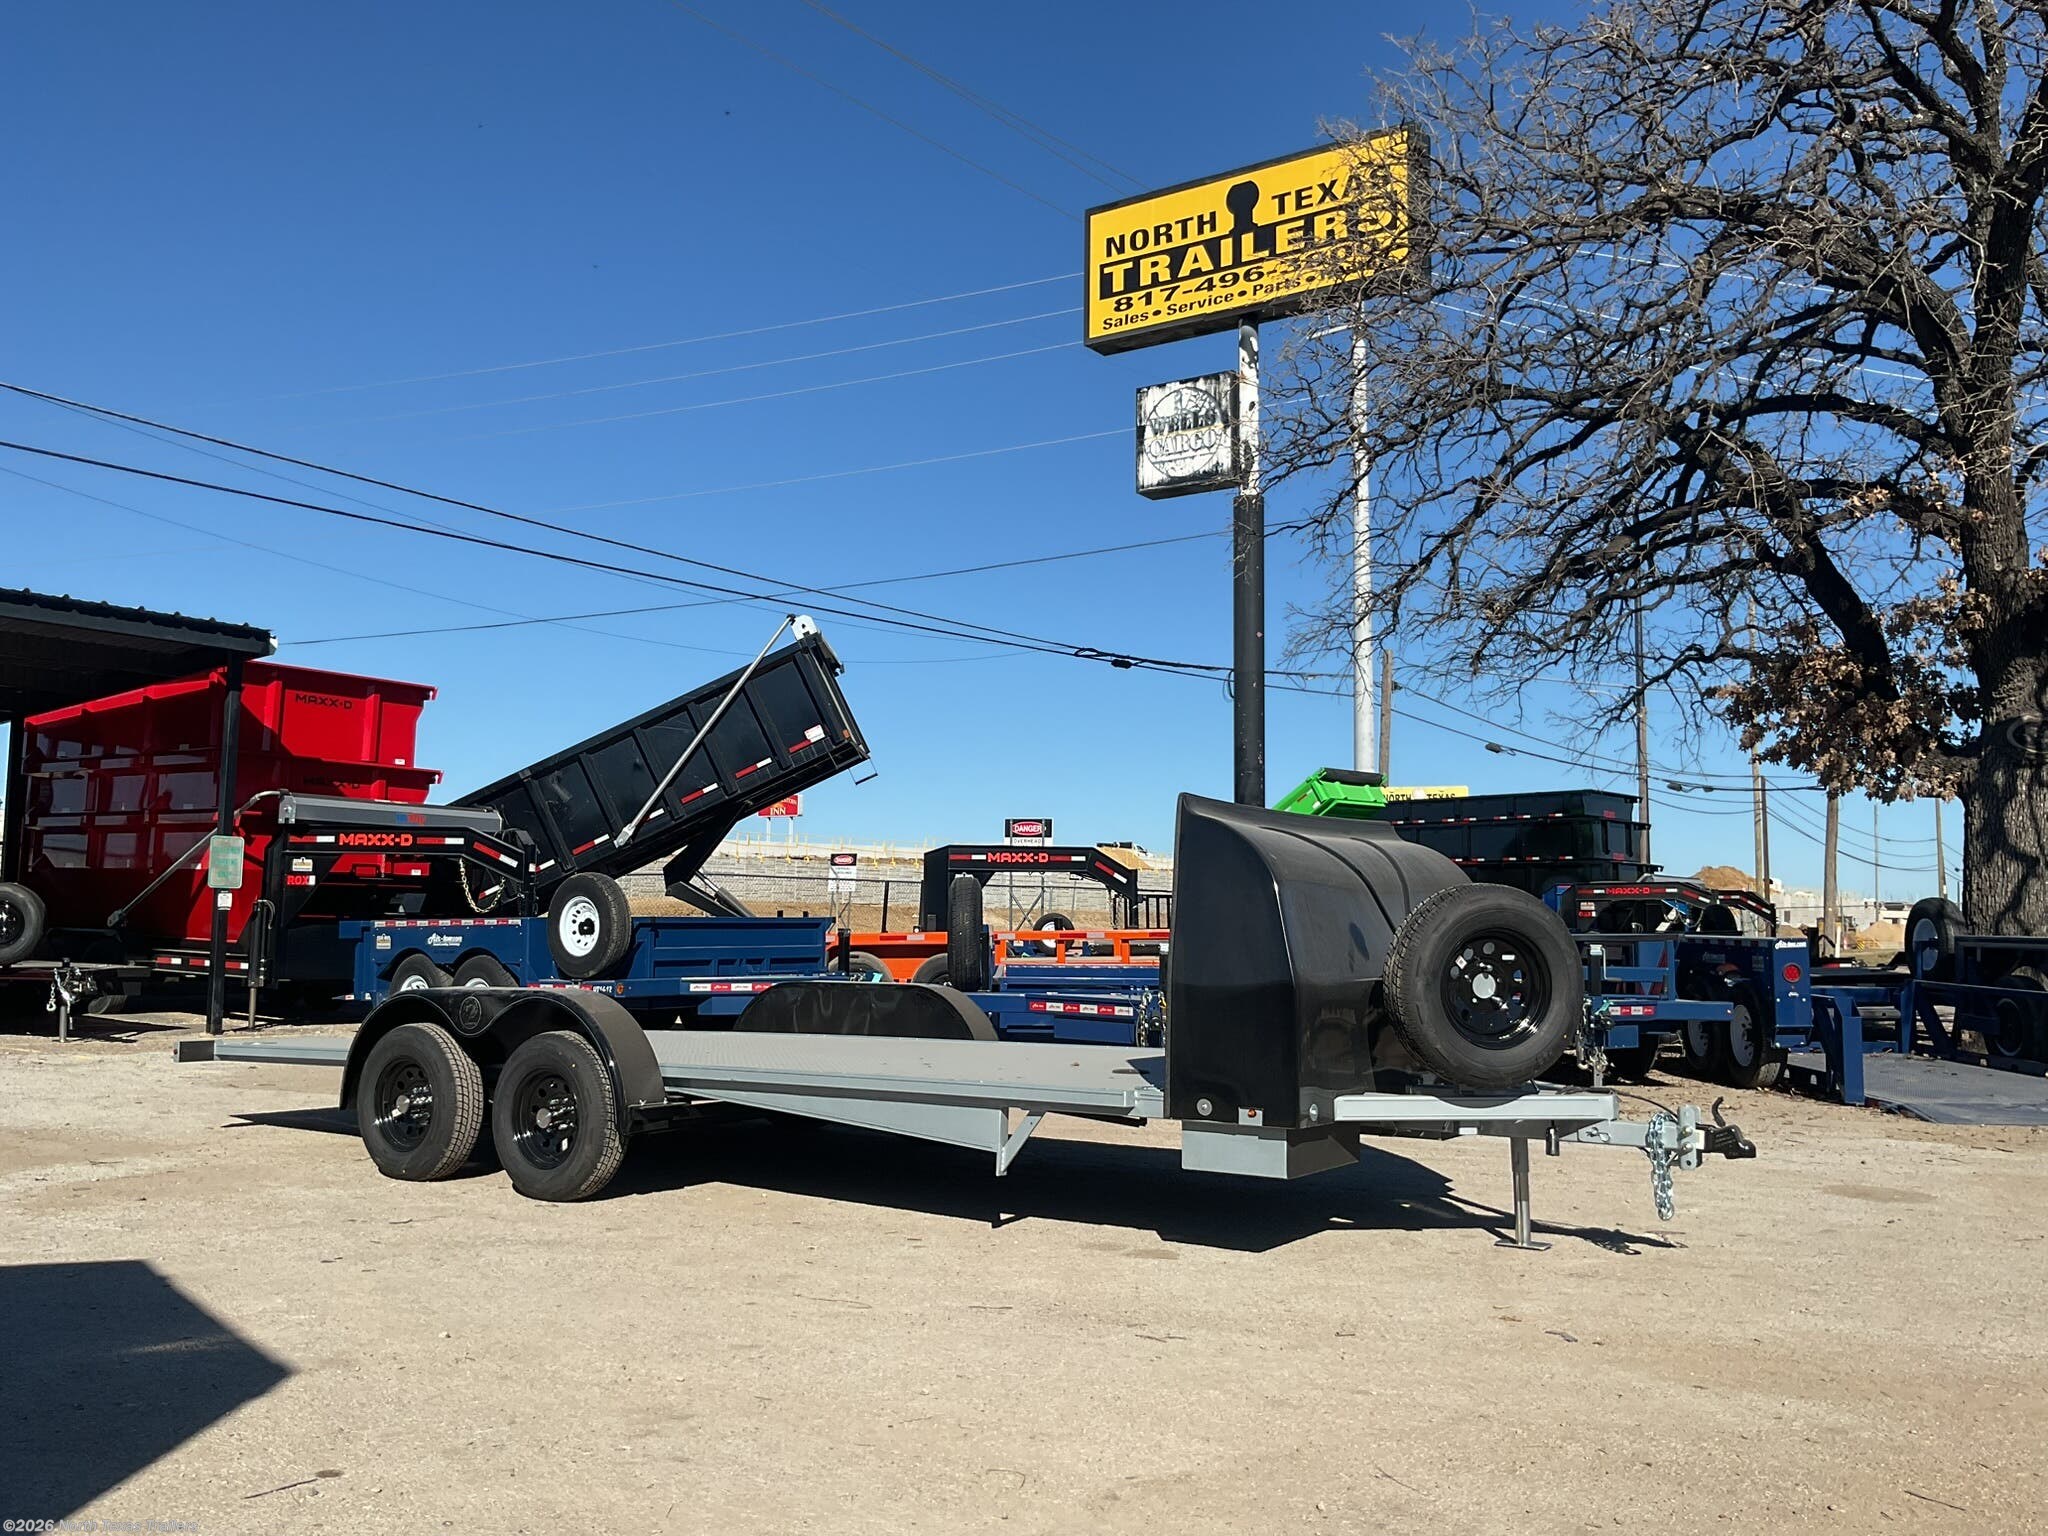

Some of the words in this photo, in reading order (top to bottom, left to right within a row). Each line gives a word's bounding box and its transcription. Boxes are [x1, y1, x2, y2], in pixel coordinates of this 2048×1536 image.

[1105, 211, 1217, 257] NORTH
[1103, 198, 1395, 293] TRAILERS
[1102, 309, 1149, 330] Sales
[1166, 289, 1234, 316] Service
[1252, 276, 1301, 297] Parts
[1150, 429, 1217, 458] CARGO
[770, 807, 787, 816] INN
[1014, 824, 1042, 833] DANGER
[338, 832, 413, 846] MAXX-D
[986, 852, 1049, 864] MAXX-D
[1605, 886, 1651, 895] MAXX-D
